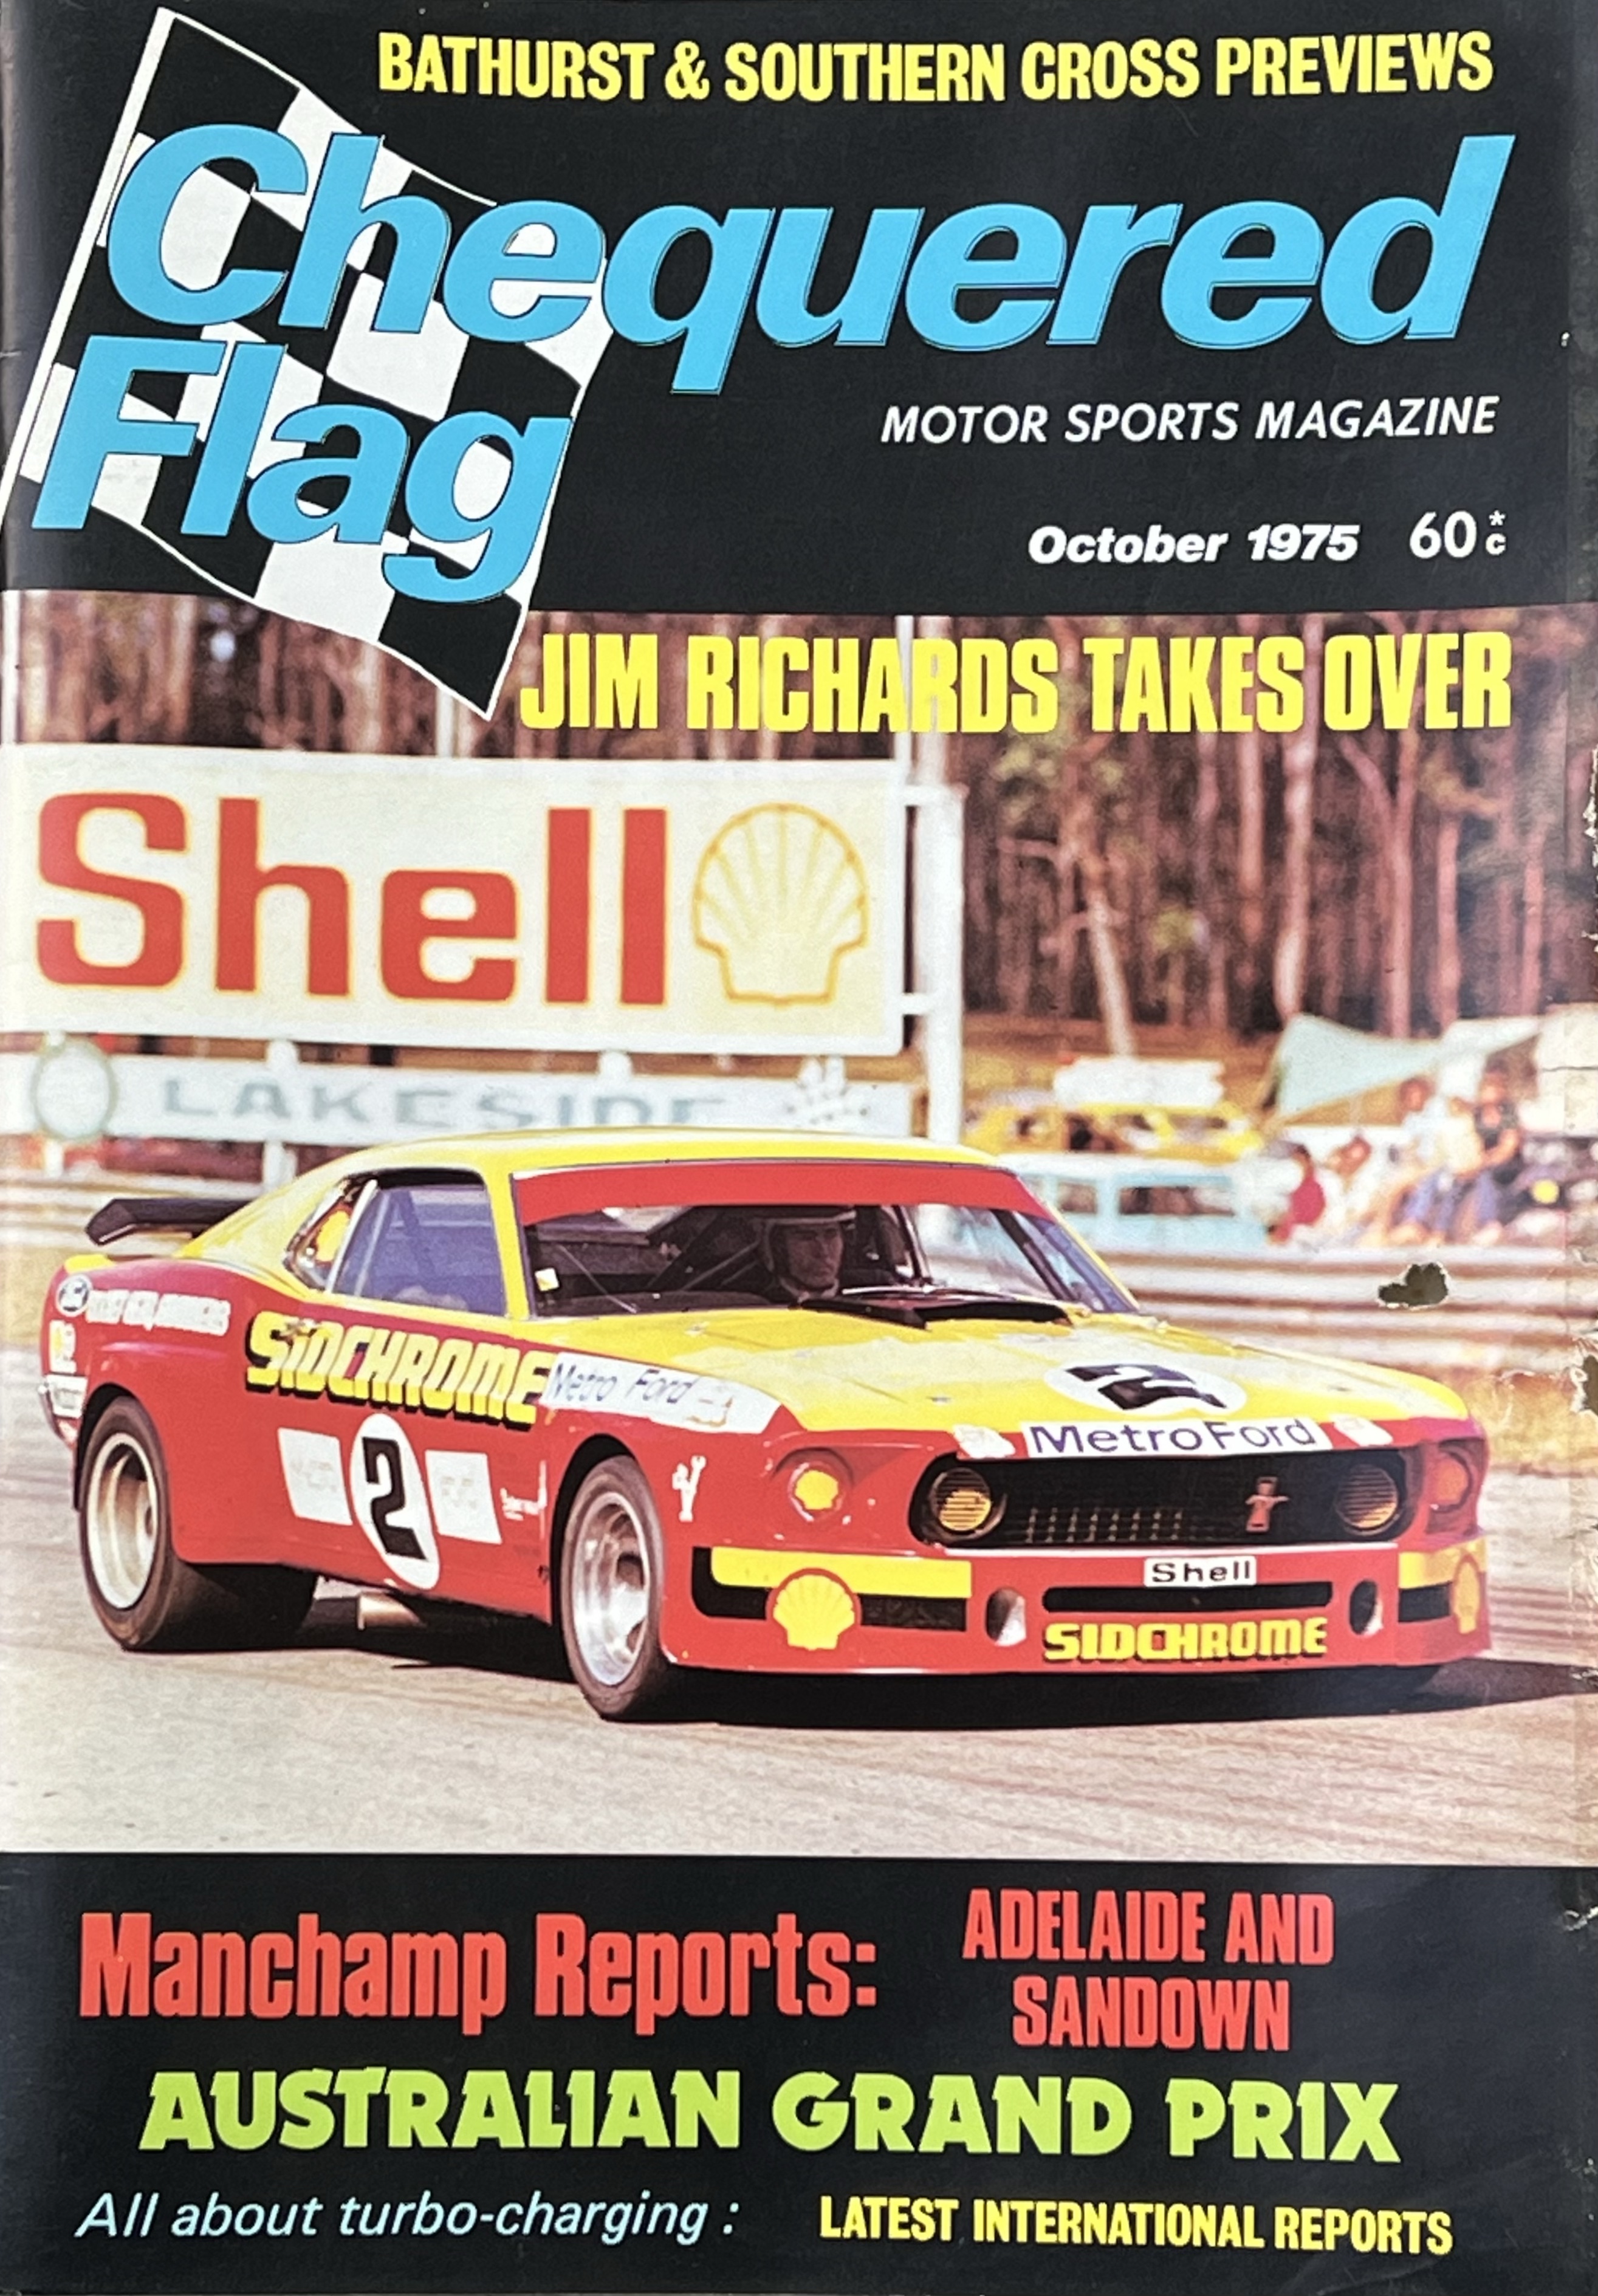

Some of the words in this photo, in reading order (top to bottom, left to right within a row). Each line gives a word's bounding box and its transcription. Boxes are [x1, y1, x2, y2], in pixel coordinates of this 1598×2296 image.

[379, 33, 653, 99] BATHURST
[666, 42, 710, 99] &
[726, 44, 1004, 101] SOUTHERN
[1023, 40, 1200, 99] CROSS
[1218, 33, 1492, 95] PREVIEWS
[108, 124, 1515, 394] Chequered
[881, 404, 1048, 444] MOTOR
[1065, 402, 1240, 442] SPORTS
[1255, 396, 1500, 439] MAGAZINE
[32, 334, 573, 603] Flag
[1028, 524, 1229, 564] October
[1247, 523, 1360, 561] 1975
[1409, 510, 1477, 559] 60
[520, 632, 659, 730] JIM
[687, 634, 1059, 735] RICHARDS
[1083, 636, 1305, 733] TAKES
[1323, 631, 1512, 731] OVER
[36, 792, 670, 1006] Shell
[244, 1311, 557, 1432] SIDCHROME
[626, 1368, 700, 1405] Ford
[361, 1436, 428, 1560] 2
[1151, 1560, 1251, 1583] Shell
[1043, 1616, 1328, 1664] SIDCHROME
[962, 1888, 1206, 1963] ADELAIDE
[1226, 1892, 1334, 1966] AND
[80, 1912, 507, 2036] Manchamp
[535, 1913, 877, 2036] Reports:
[1012, 1975, 1291, 2051] SANDOWN
[139, 2066, 741, 2150] AUSTRALIAN
[772, 2071, 1133, 2156] GRAND
[1165, 2078, 1402, 2163] PRIX
[74, 2192, 159, 2238] All
[171, 2191, 323, 2236] about
[340, 2190, 709, 2246] turbo-charging
[820, 2196, 959, 2241] LATEST
[973, 2198, 1264, 2249] INTERNATIONAL
[1275, 2206, 1453, 2256] REPORTS
